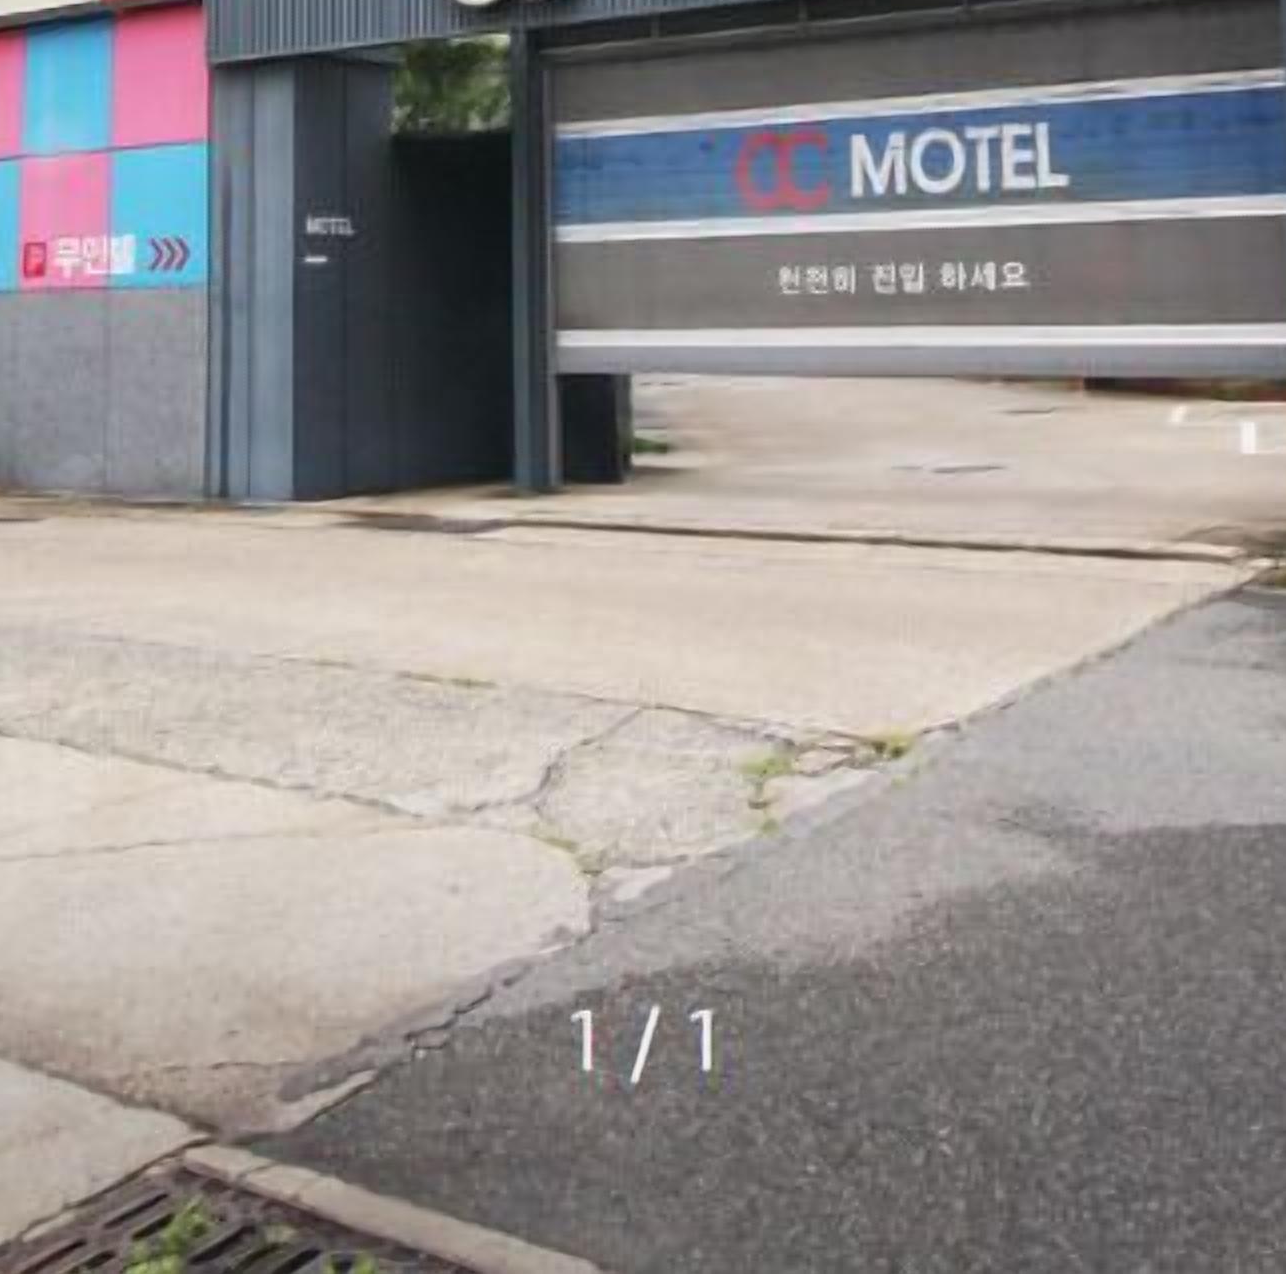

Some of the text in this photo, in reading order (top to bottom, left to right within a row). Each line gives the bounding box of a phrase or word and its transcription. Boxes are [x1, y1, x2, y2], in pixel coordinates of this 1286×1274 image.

[849, 122, 1070, 198] MOTEL
[778, 260, 1031, 294] 천천히 진입 하세요
